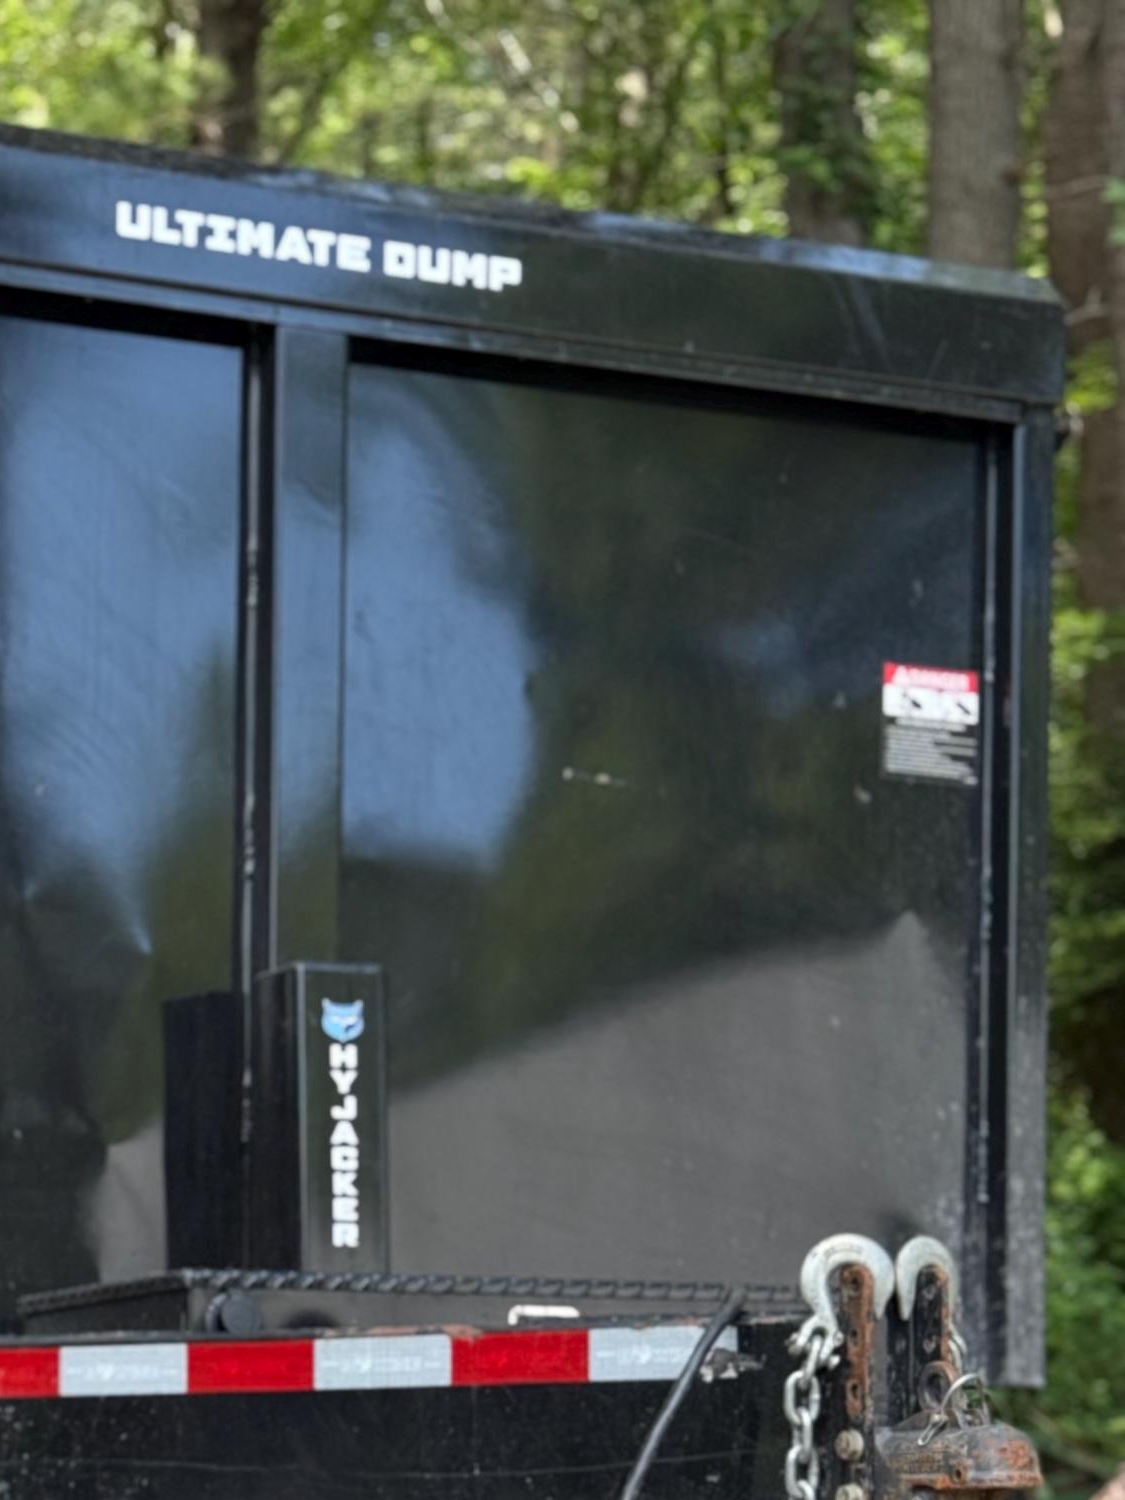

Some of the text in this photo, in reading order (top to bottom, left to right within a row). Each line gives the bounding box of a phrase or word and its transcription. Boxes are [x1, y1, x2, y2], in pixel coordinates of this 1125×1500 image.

[115, 200, 522, 292] ULTIMATE DUMP
[329, 1043, 360, 1248] HYJACKER
